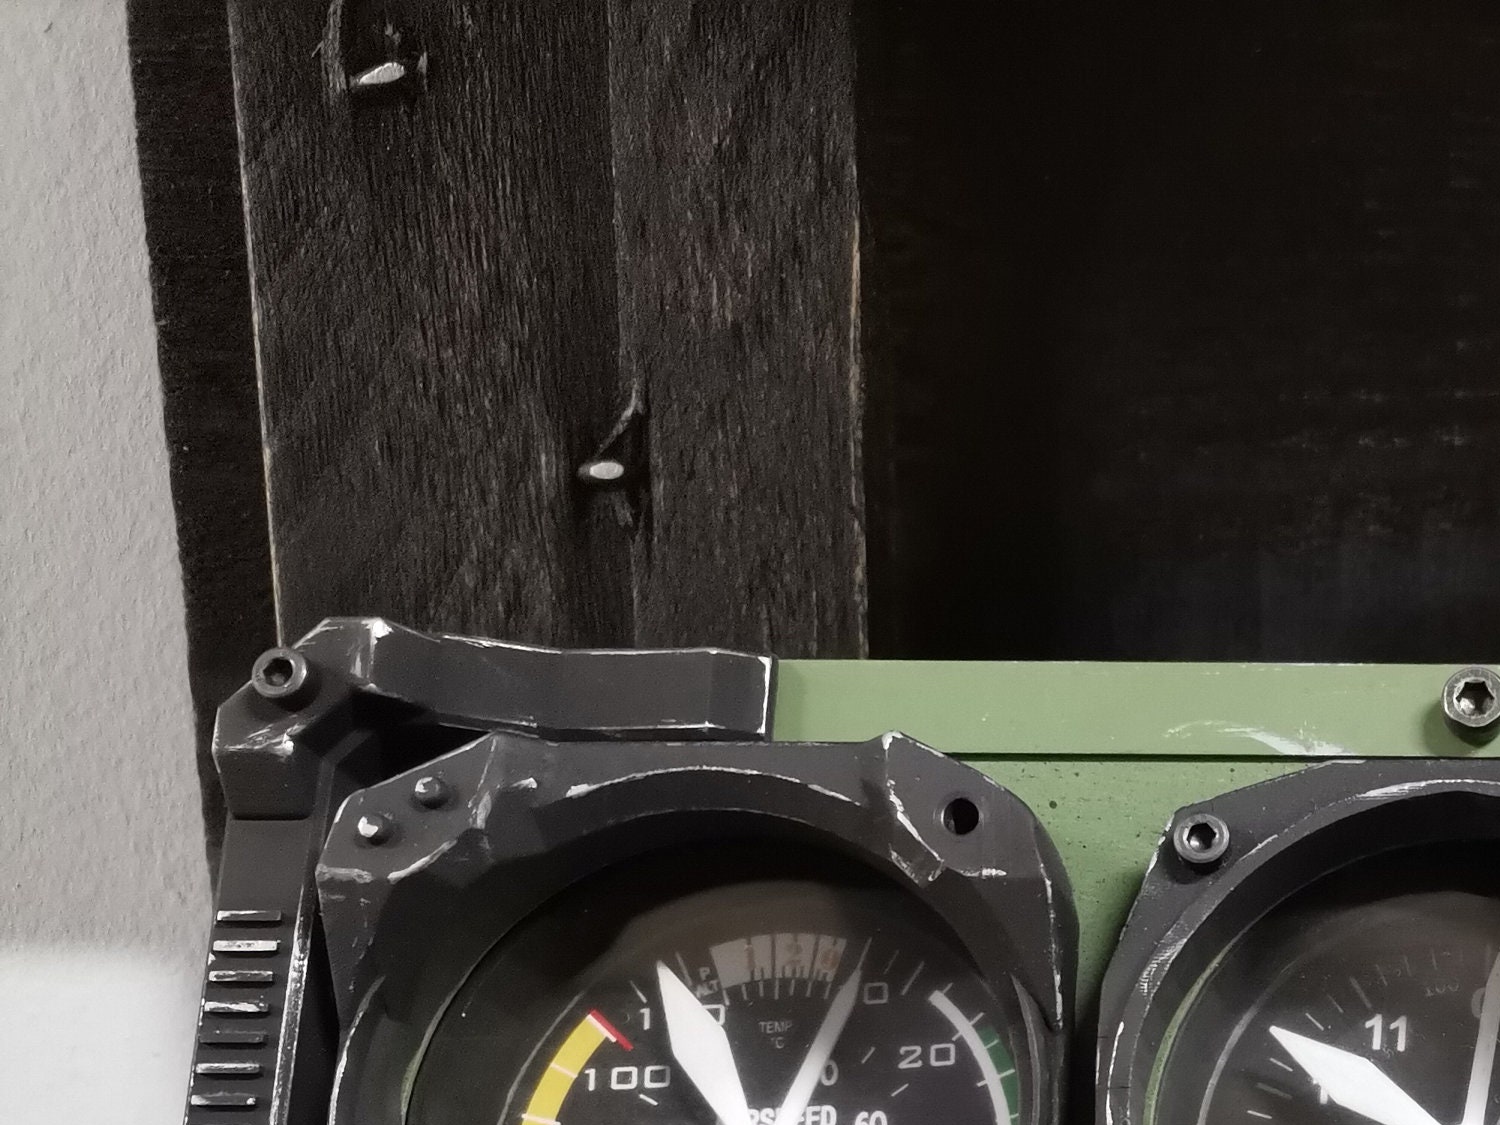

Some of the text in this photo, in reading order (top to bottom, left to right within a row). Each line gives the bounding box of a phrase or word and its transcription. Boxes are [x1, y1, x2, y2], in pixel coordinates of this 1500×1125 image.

[759, 1020, 792, 1034] TEMP
[1365, 1013, 1407, 1052] 11
[898, 1042, 956, 1069] 20
[584, 1065, 671, 1091] 100
